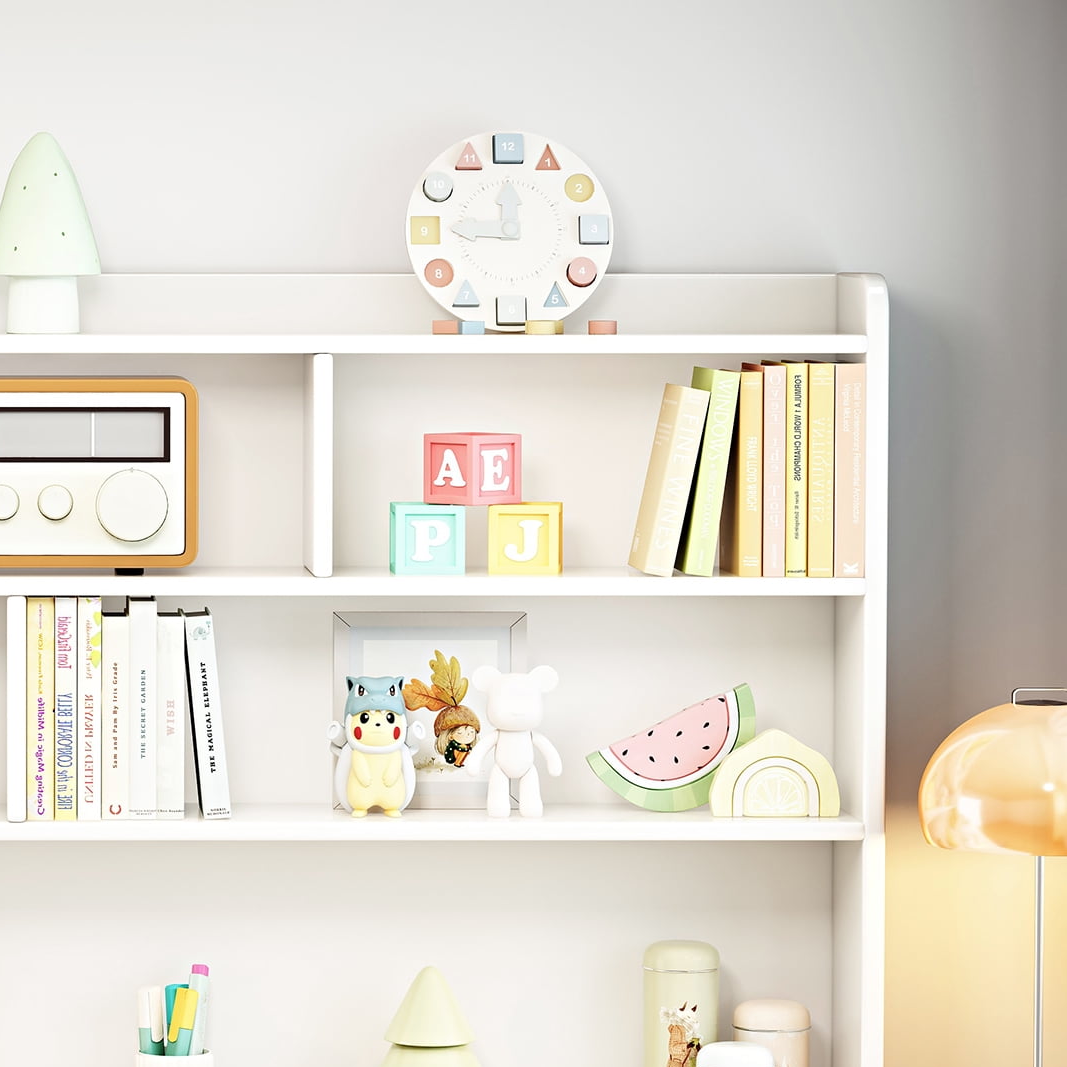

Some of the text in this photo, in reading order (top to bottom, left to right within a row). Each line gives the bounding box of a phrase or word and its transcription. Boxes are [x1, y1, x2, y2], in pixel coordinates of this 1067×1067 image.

[501, 142, 515, 151] 12
[463, 154, 476, 162] 11
[544, 158, 551, 167] 1
[432, 180, 445, 188] 10
[575, 184, 583, 193] 2
[420, 227, 428, 237] 9
[590, 224, 598, 233] 3
[435, 269, 443, 279] 8
[578, 266, 586, 275] 4
[463, 291, 469, 300] 7
[551, 295, 559, 304] 5
[432, 448, 468, 488] A
[479, 448, 511, 492] E
[409, 519, 451, 563] P
[503, 519, 544, 563] J
[112, 705, 119, 715] By
[166, 700, 175, 736] WISH
[199, 662, 217, 774] THE MAGICAL ELEPHANT
